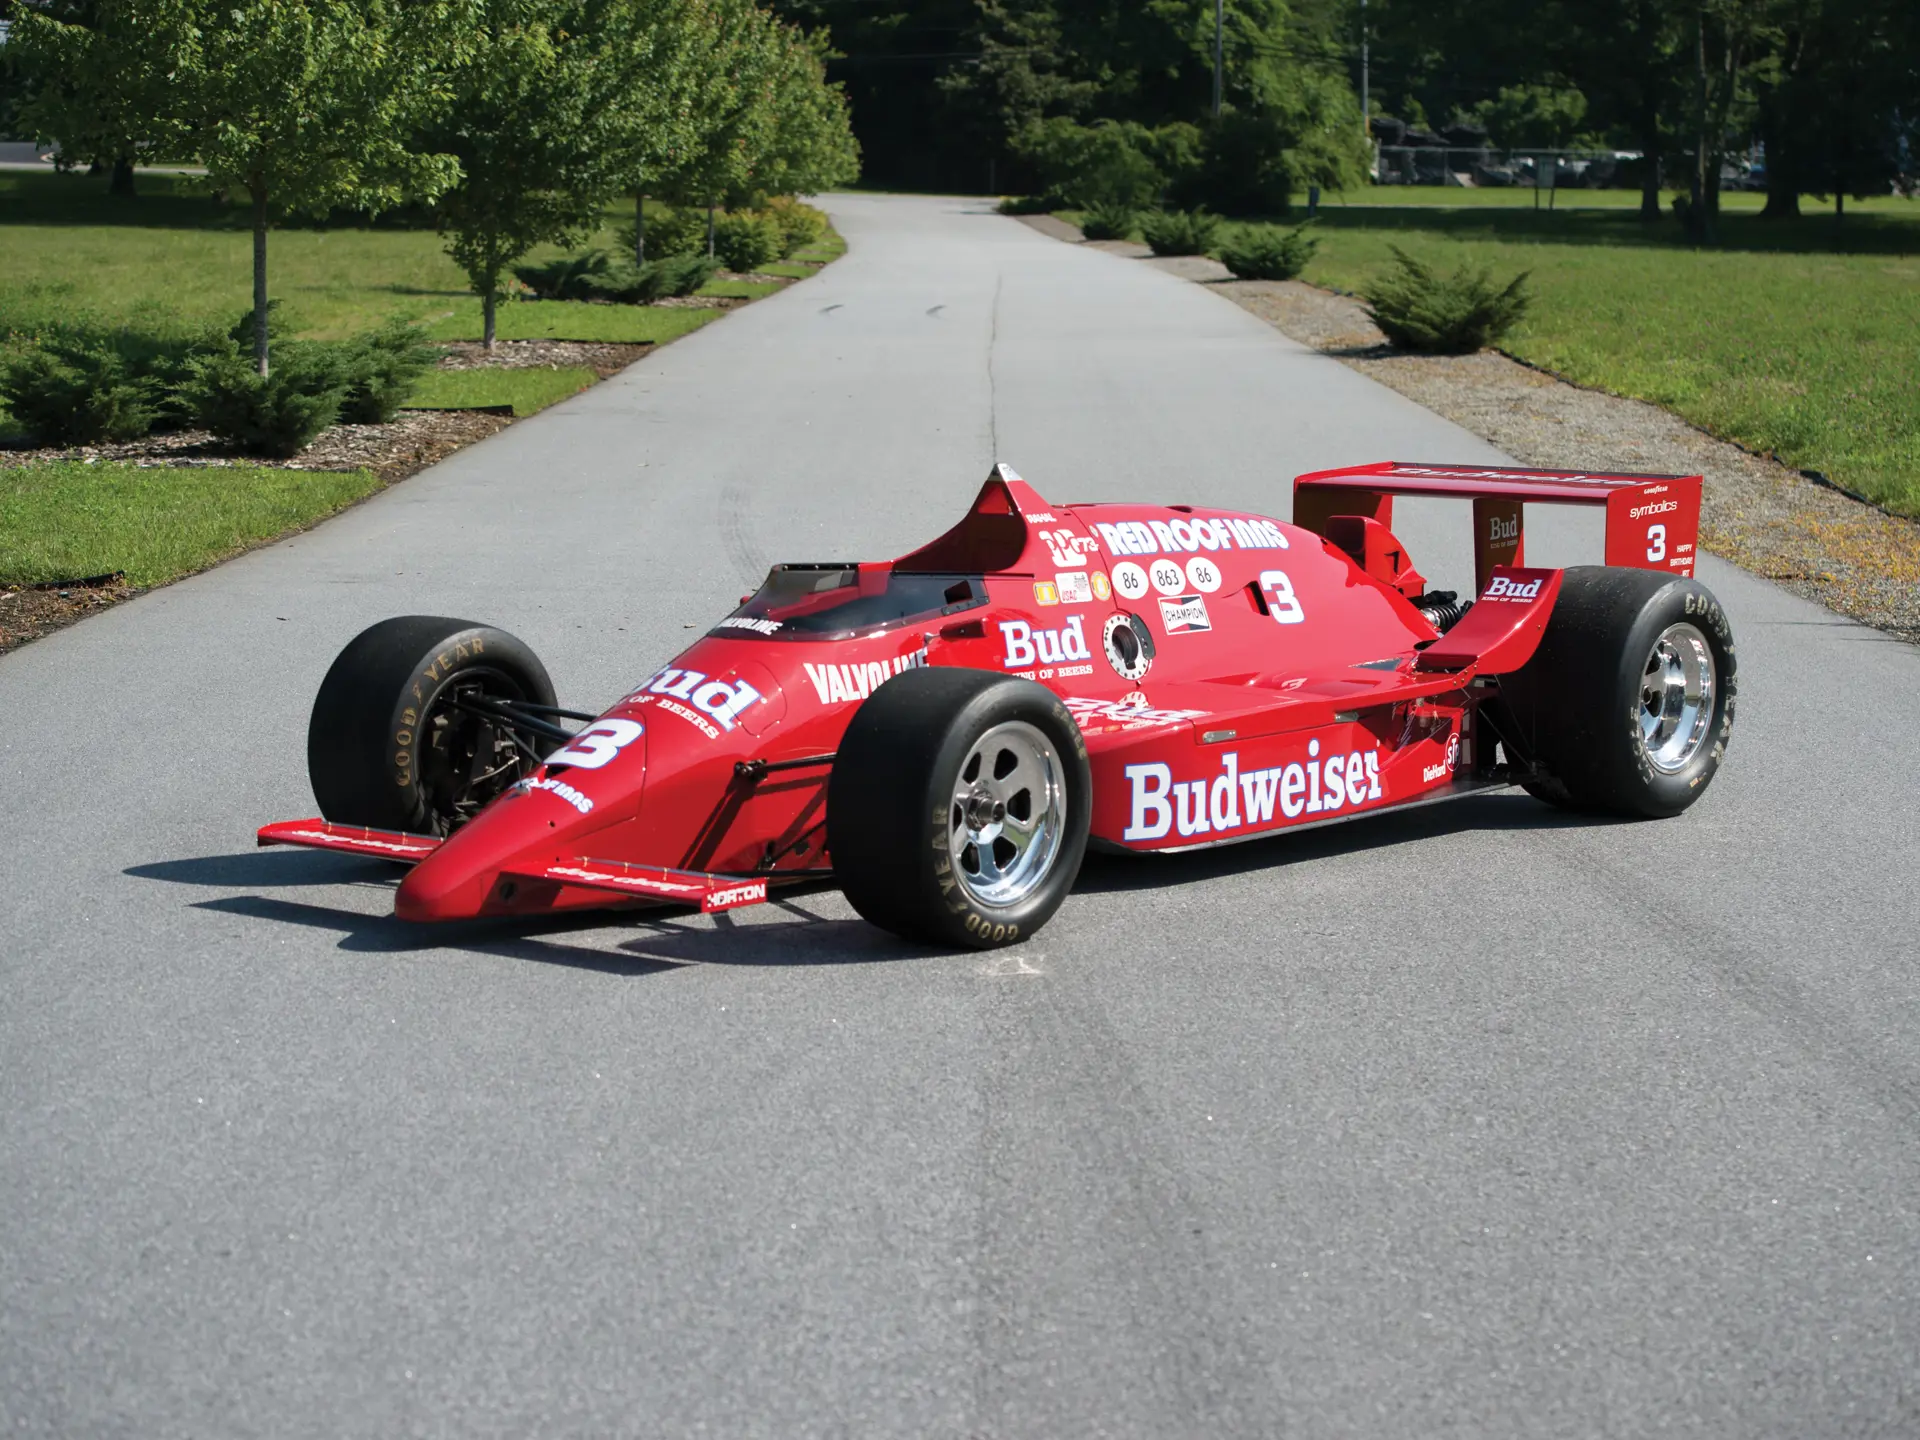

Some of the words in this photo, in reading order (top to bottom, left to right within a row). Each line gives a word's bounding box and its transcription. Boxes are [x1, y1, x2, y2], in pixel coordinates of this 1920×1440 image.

[1629, 500, 1678, 520] symbolics
[1095, 521, 1158, 557] RED
[1147, 518, 1233, 553] ROOF
[1489, 513, 1518, 541] Bud
[1646, 523, 1667, 563] 3
[1676, 544, 1693, 553] HAPPY
[1669, 557, 1694, 567] BIRTHDAY
[1122, 573, 1139, 590] 86
[1156, 569, 1180, 587] 863
[1195, 566, 1213, 584] 86
[1484, 576, 1544, 598] Bud
[1258, 569, 1306, 625] 3
[1164, 607, 1206, 623] CHAMPION
[998, 614, 1092, 668] Bud
[1012, 670, 1036, 681] NG
[1039, 669, 1054, 679] OF
[1058, 664, 1094, 678] BEERS
[628, 664, 761, 733] ud
[656, 699, 720, 740] BEERS
[541, 717, 645, 770] 3
[1423, 759, 1447, 783] DieHard
[1123, 738, 1382, 842] Budweiser
[706, 883, 766, 908] HORTON
